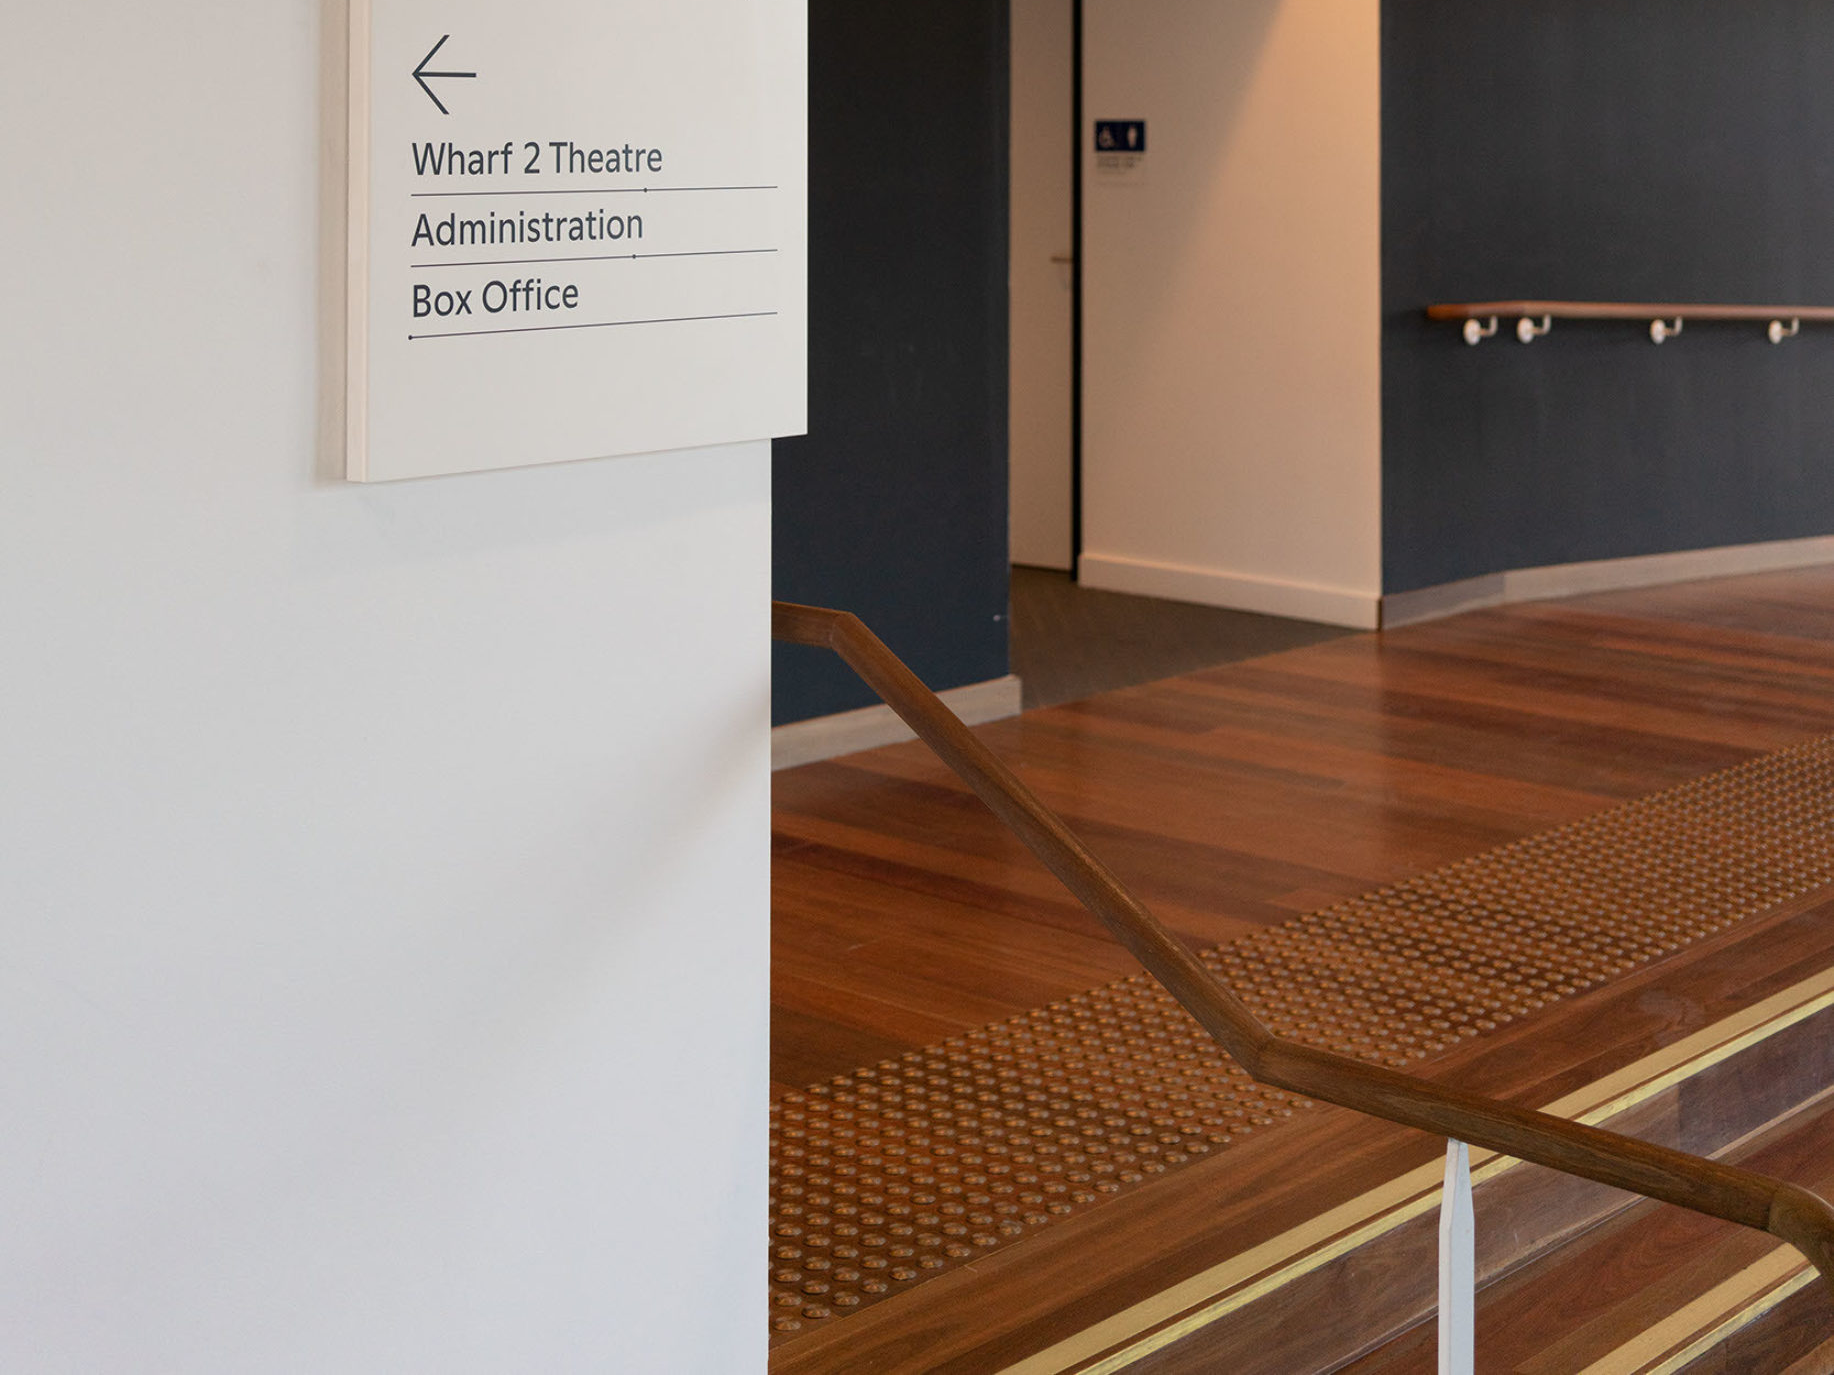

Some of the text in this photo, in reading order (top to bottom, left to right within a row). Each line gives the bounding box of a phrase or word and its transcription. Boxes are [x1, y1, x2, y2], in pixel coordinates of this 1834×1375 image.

[411, 141, 663, 176] Wharf 2 Theatre
[410, 208, 643, 248] Administration
[412, 278, 579, 318] Box Office
